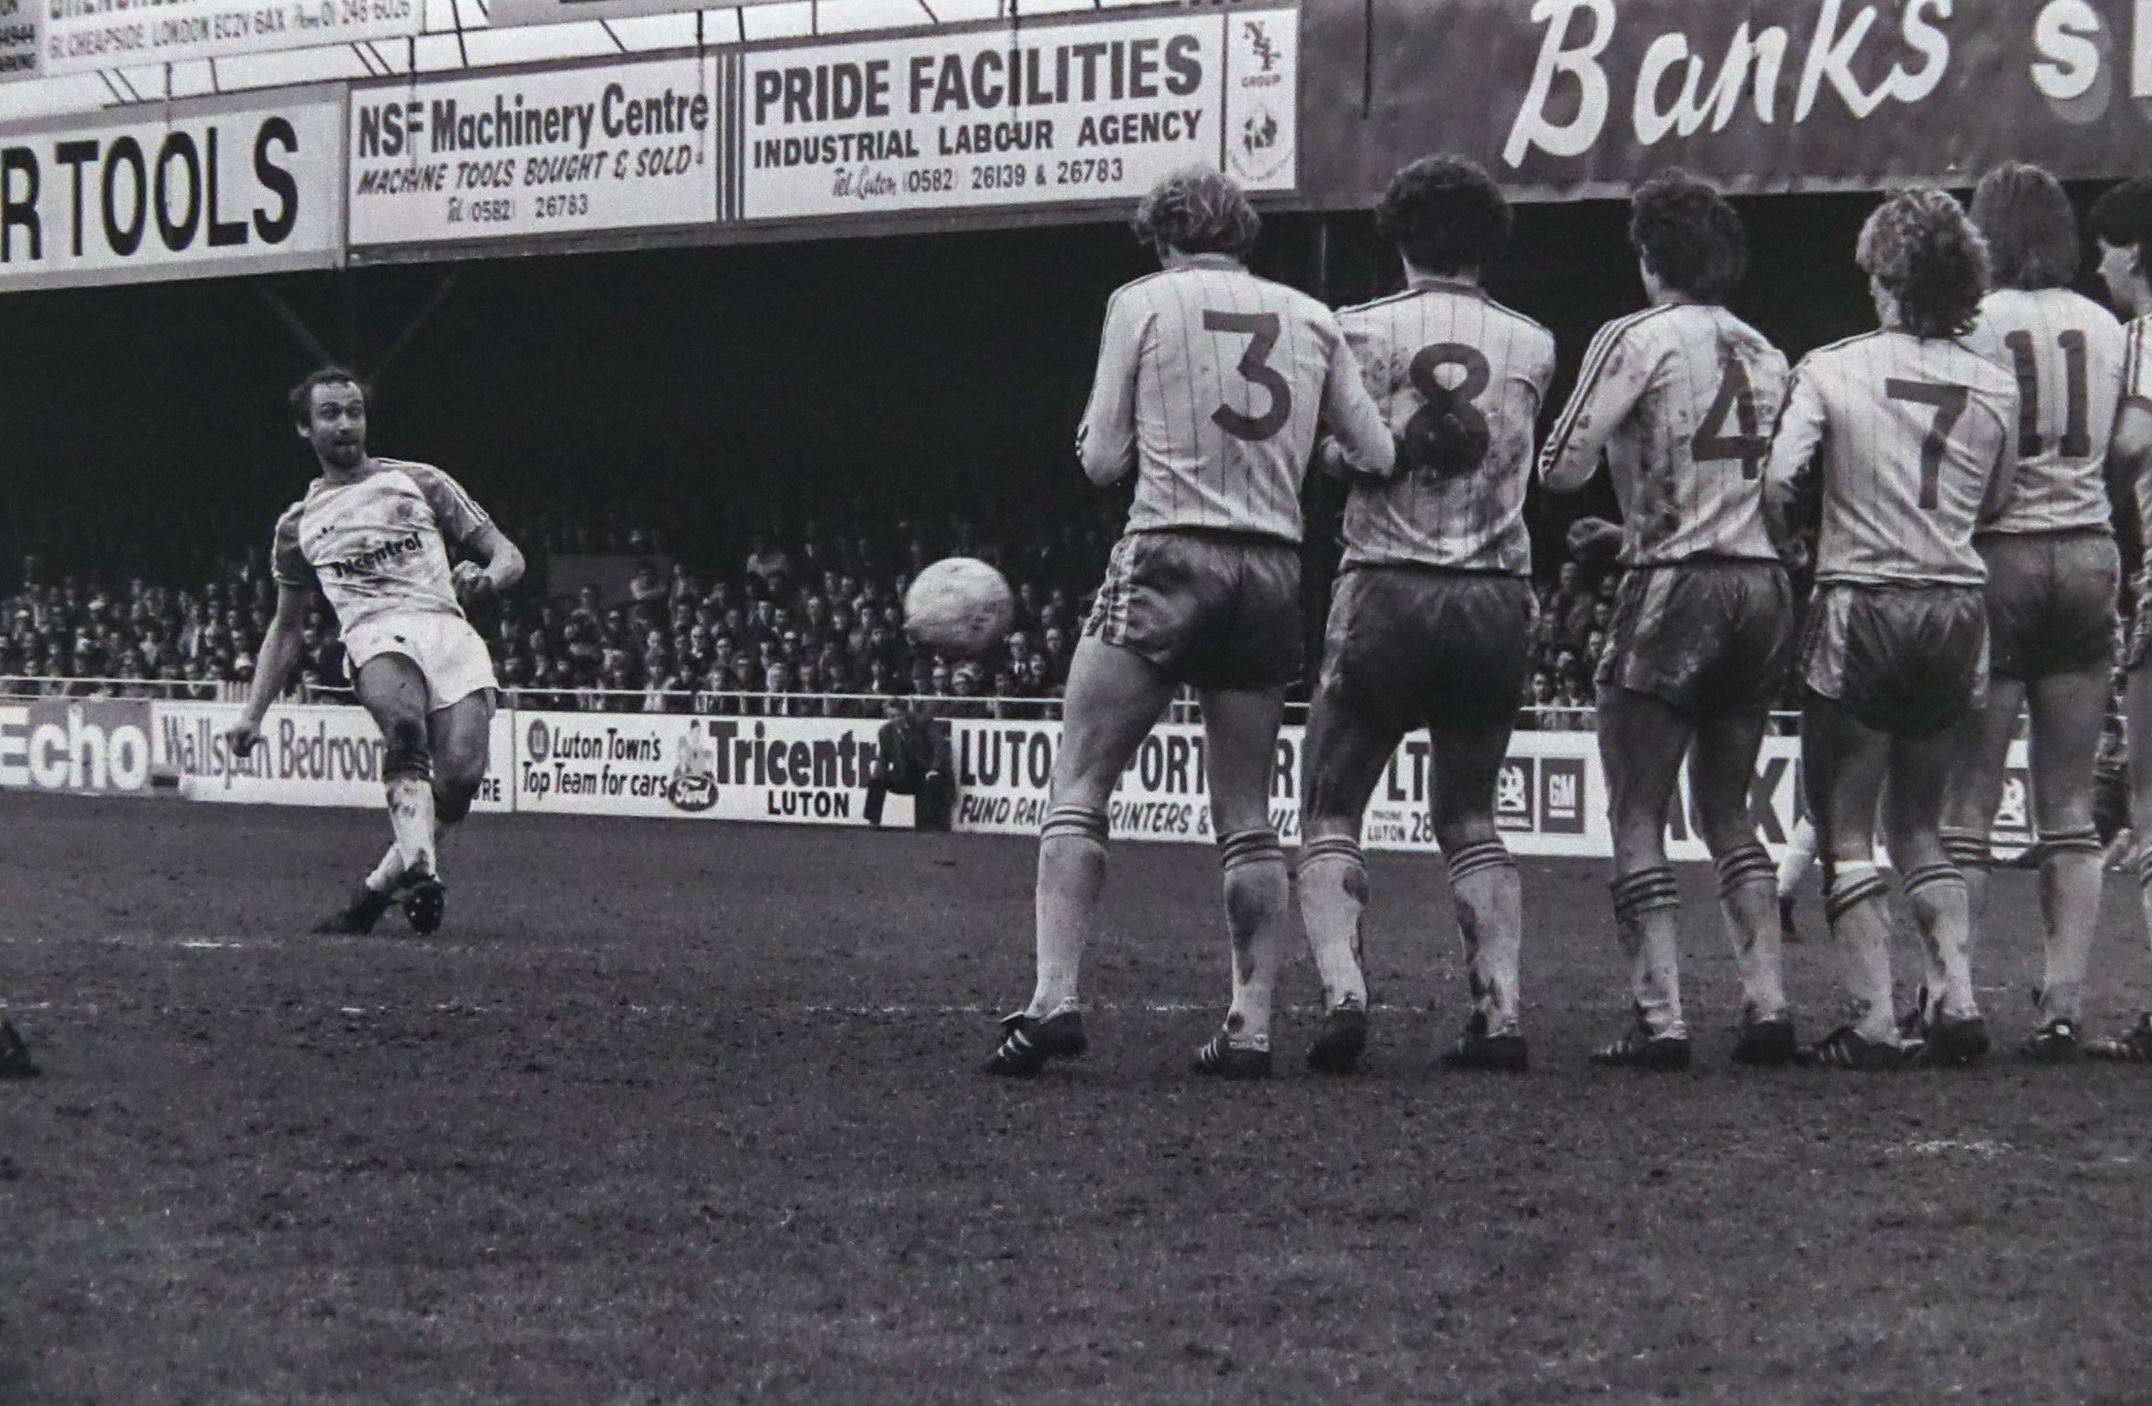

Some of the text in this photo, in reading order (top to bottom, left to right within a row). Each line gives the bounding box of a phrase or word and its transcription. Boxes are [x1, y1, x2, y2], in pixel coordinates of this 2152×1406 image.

[153, 17, 209, 47] LONDON
[755, 34, 1202, 125] PRIDE FACILITIES
[1502, 0, 1950, 168] Banks
[359, 82, 710, 157] NSF Machinery Centre
[753, 109, 1204, 169] INDUSTRIAL LABOUR AGENCY
[54, 116, 299, 258] TOOLS
[356, 163, 449, 195] MACHINE
[455, 158, 515, 190] TOOLS
[523, 150, 609, 187] BOUGHT
[613, 149, 629, 181] &
[533, 194, 590, 218] 26783
[971, 163, 1027, 191] 26139
[1056, 157, 1125, 185] 26783
[1202, 309, 1293, 442] 3
[1402, 341, 1492, 477] 8
[2004, 329, 2092, 459] 11
[1690, 345, 1772, 480] 4
[1884, 377, 1969, 510] 7
[0, 703, 150, 791] Echo
[553, 727, 661, 761] Luton Town's
[709, 721, 878, 788] Tricentr
[960, 728, 1063, 789] LUTO
[1387, 741, 1431, 802] LT
[523, 761, 668, 801] Top Team for cars
[768, 789, 850, 818] LUTON
[959, 794, 1011, 824] FUND
[1109, 800, 1193, 835] RINTERS
[1410, 811, 1434, 843] 28
